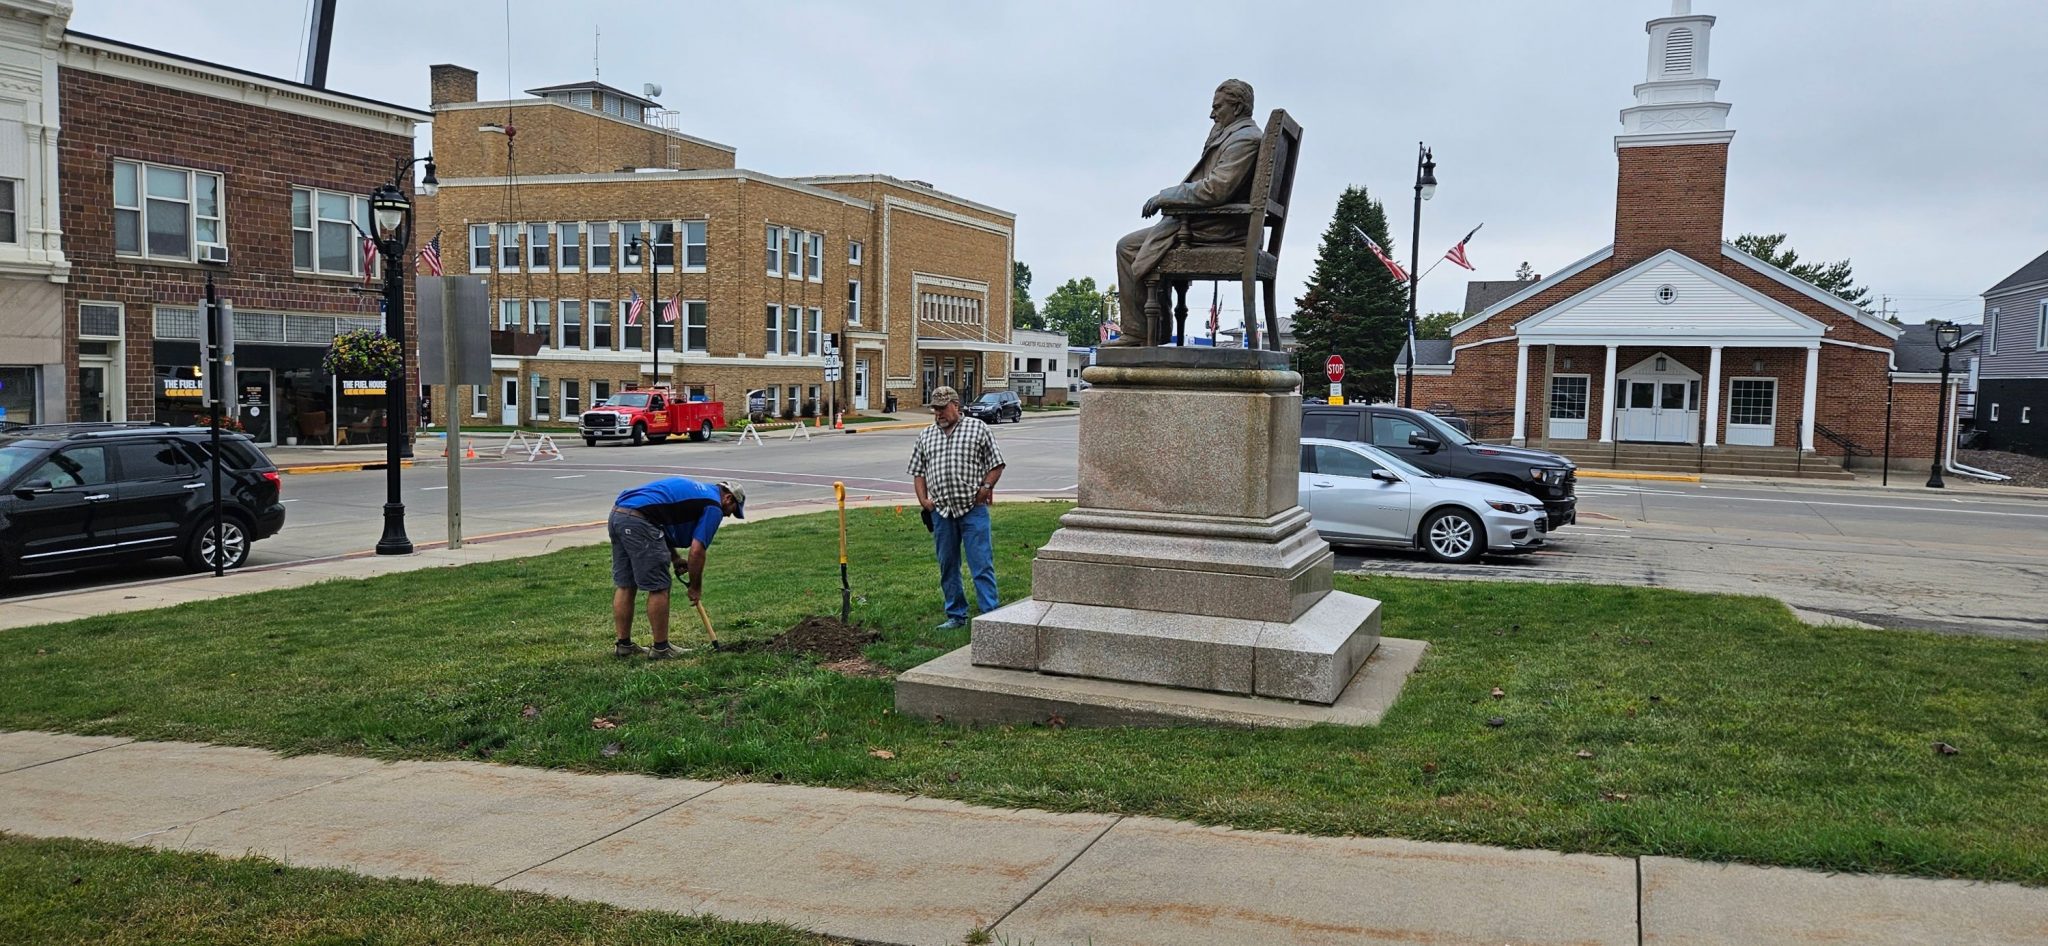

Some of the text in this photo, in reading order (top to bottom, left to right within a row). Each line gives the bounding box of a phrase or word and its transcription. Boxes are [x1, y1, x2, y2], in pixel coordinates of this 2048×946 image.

[825, 358, 831, 366] 35
[1328, 363, 1344, 374] STOP
[164, 380, 178, 388] THE
[180, 380, 196, 388] FUEL
